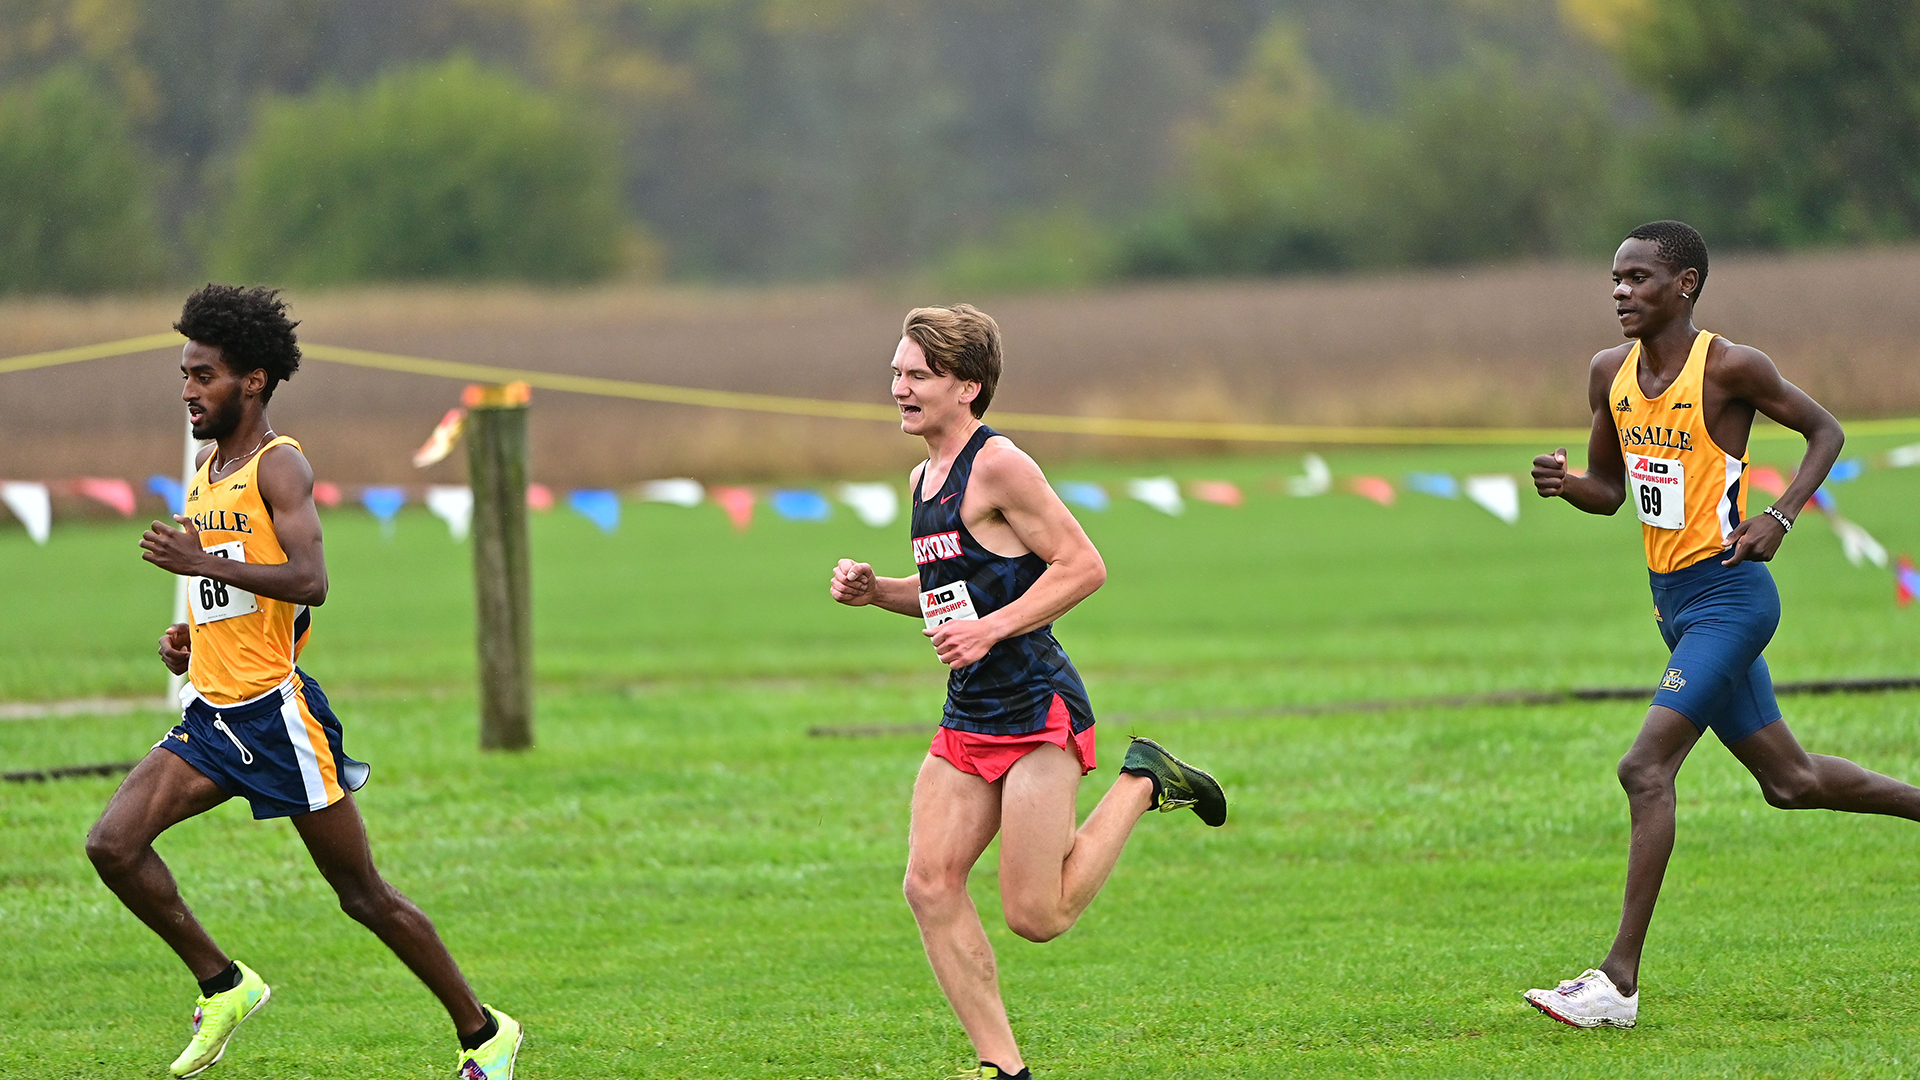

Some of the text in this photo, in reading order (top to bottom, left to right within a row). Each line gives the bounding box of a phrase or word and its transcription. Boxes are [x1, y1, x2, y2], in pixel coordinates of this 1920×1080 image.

[1634, 457, 1669, 475] A10
[1631, 470, 1679, 485] CHAMPIONSHIPS
[1640, 484, 1662, 517] 69
[191, 510, 252, 534] SALLE
[200, 578, 229, 611] 68
[926, 590, 955, 608] A10
